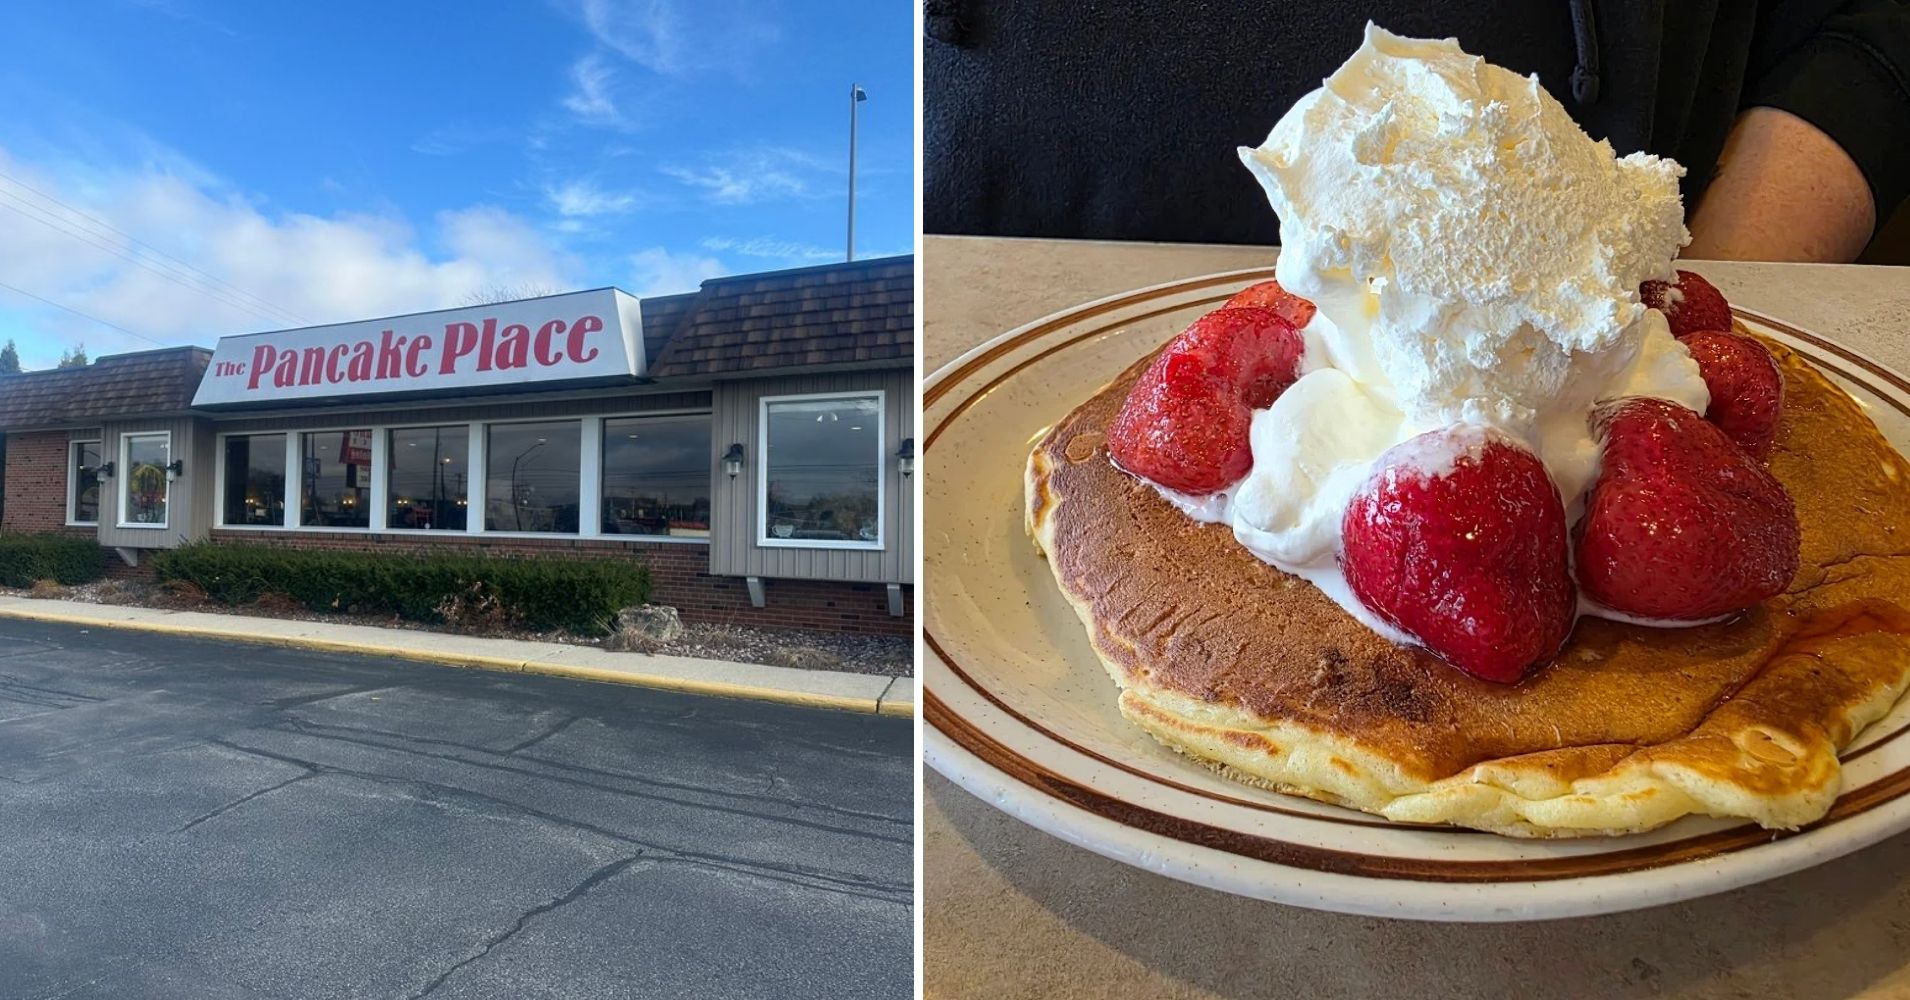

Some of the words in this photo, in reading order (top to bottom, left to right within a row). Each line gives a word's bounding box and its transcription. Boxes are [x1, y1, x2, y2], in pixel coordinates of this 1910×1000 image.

[215, 361, 247, 378] The
[247, 330, 432, 390] Pancake
[438, 315, 604, 375] Place
